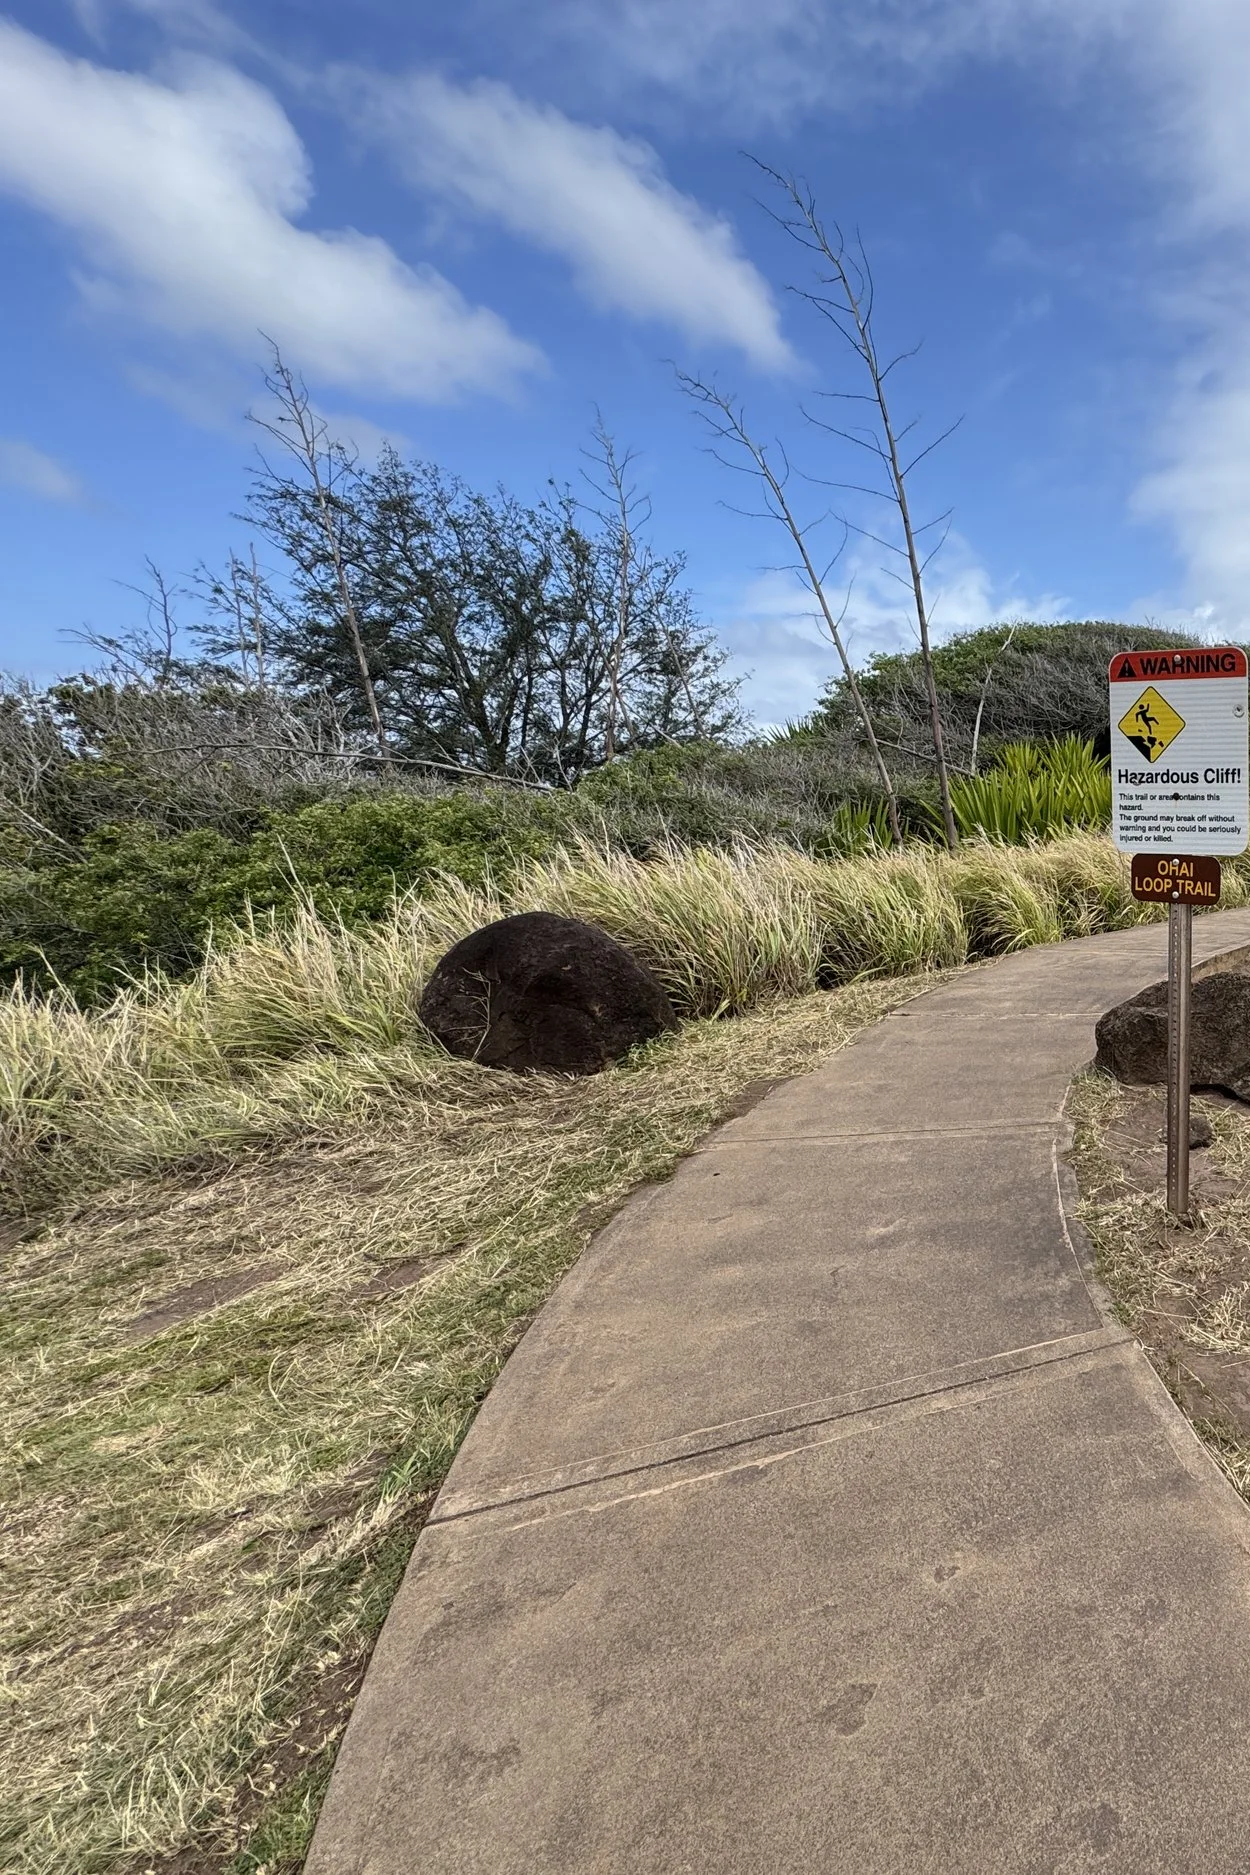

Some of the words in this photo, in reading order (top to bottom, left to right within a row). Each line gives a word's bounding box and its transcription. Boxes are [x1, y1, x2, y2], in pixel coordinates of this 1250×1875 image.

[1140, 653, 1236, 676] WARNING
[1118, 768, 1199, 784] Hazardous
[1204, 768, 1241, 784] Cliff!
[1134, 814, 1158, 822] ground
[1120, 824, 1146, 833] warning
[1162, 825, 1175, 833] you
[1208, 826, 1241, 834] seriously
[1120, 834, 1143, 843] injured
[1158, 860, 1194, 878] OHAI
[1135, 876, 1172, 892] LOOP
[1176, 880, 1216, 897] TRAIL
